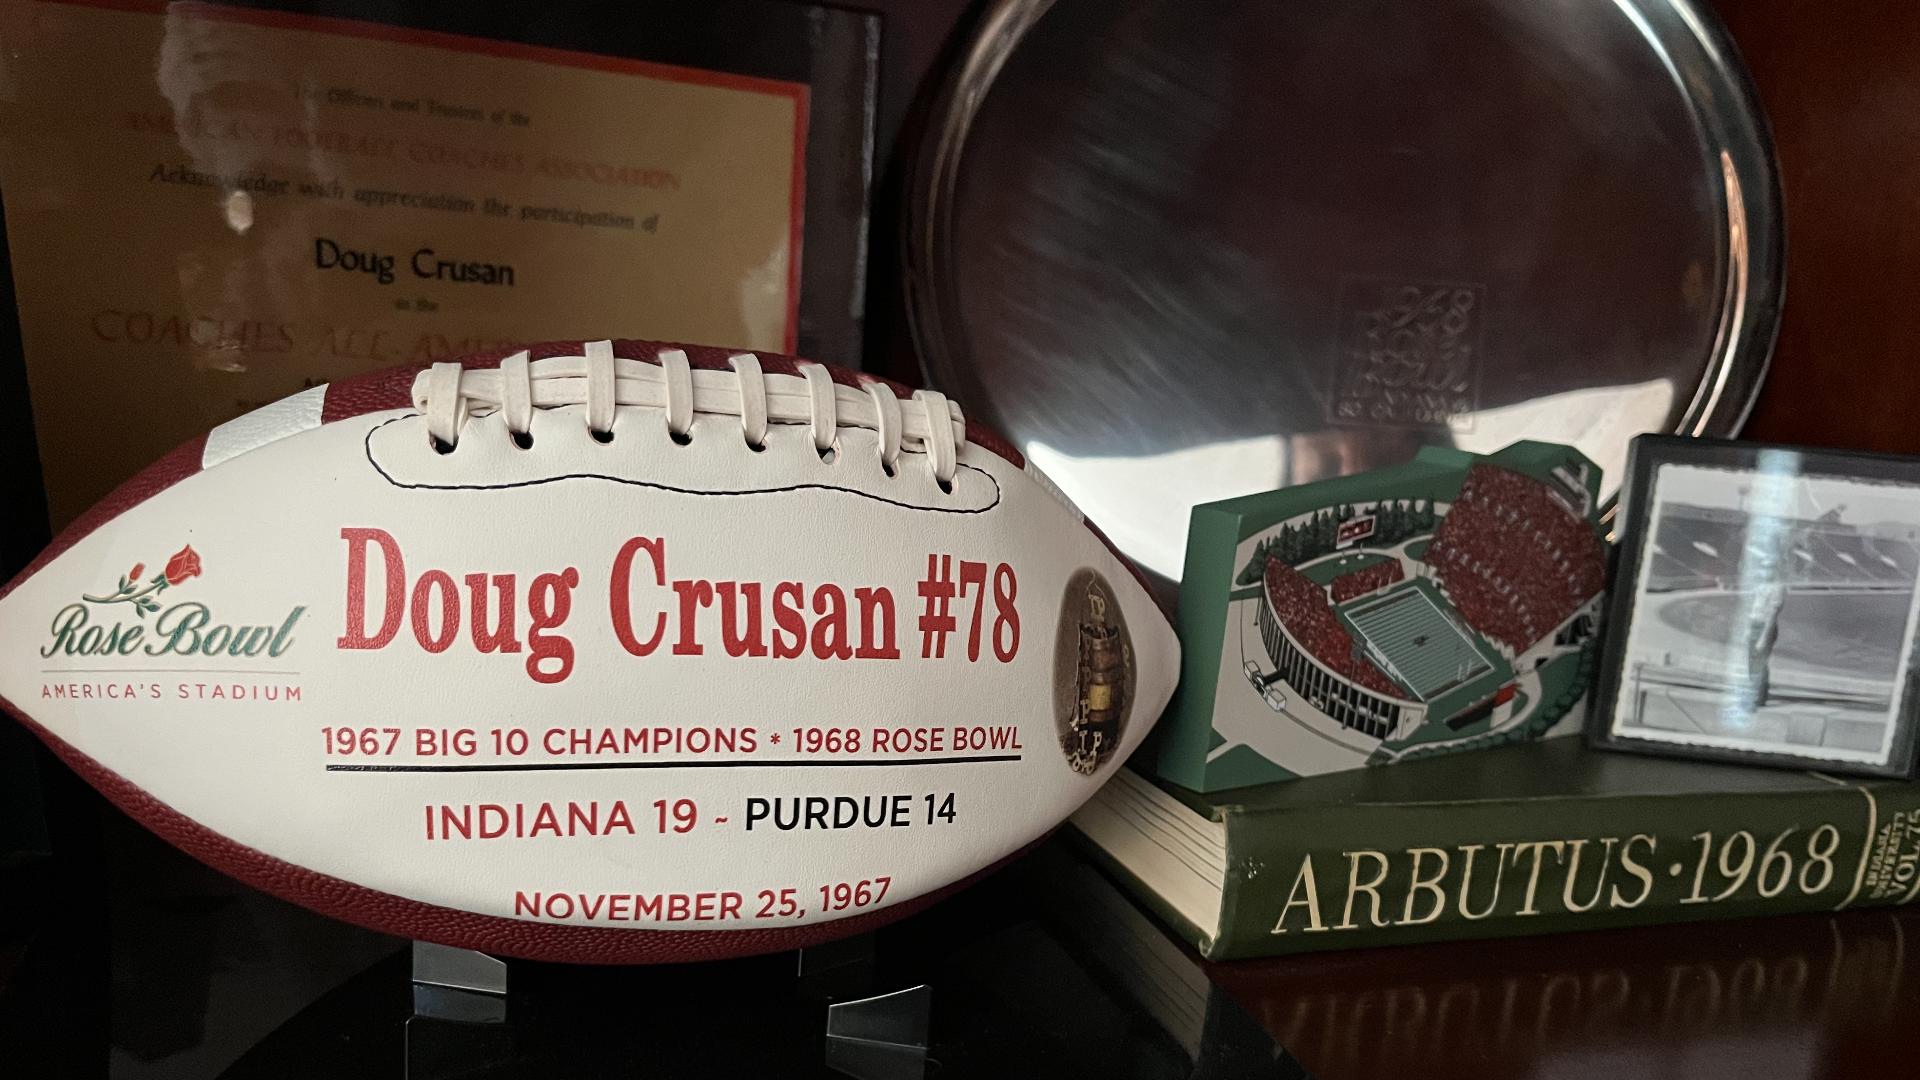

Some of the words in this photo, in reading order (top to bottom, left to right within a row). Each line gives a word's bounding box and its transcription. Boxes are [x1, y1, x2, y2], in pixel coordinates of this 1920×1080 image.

[353, 188, 475, 214] appreciation
[482, 196, 511, 218] the
[519, 204, 635, 231] participation
[315, 238, 395, 285] Doug
[411, 248, 515, 287] Crusan
[336, 527, 580, 685] Doug
[609, 536, 902, 661] Crusan
[916, 553, 1022, 664] #78
[40, 603, 146, 660] Rose
[144, 601, 307, 659] Bowl
[41, 683, 162, 700] AMERICA'S
[178, 683, 302, 702] STADIUM
[321, 726, 402, 756] 1967
[415, 728, 478, 757] BIG
[490, 728, 530, 756] 10
[542, 727, 758, 756] CHAMPIONS
[792, 727, 862, 754] 1968
[871, 727, 946, 754] ROSE
[952, 725, 1023, 751] BOWL
[425, 800, 636, 841] INDIANA
[652, 798, 698, 834] 19
[745, 794, 912, 833] PURDUE
[924, 792, 957, 826] 14
[514, 889, 743, 922] NOVEMBER
[756, 887, 806, 919] 25,
[820, 876, 893, 914] 1967
